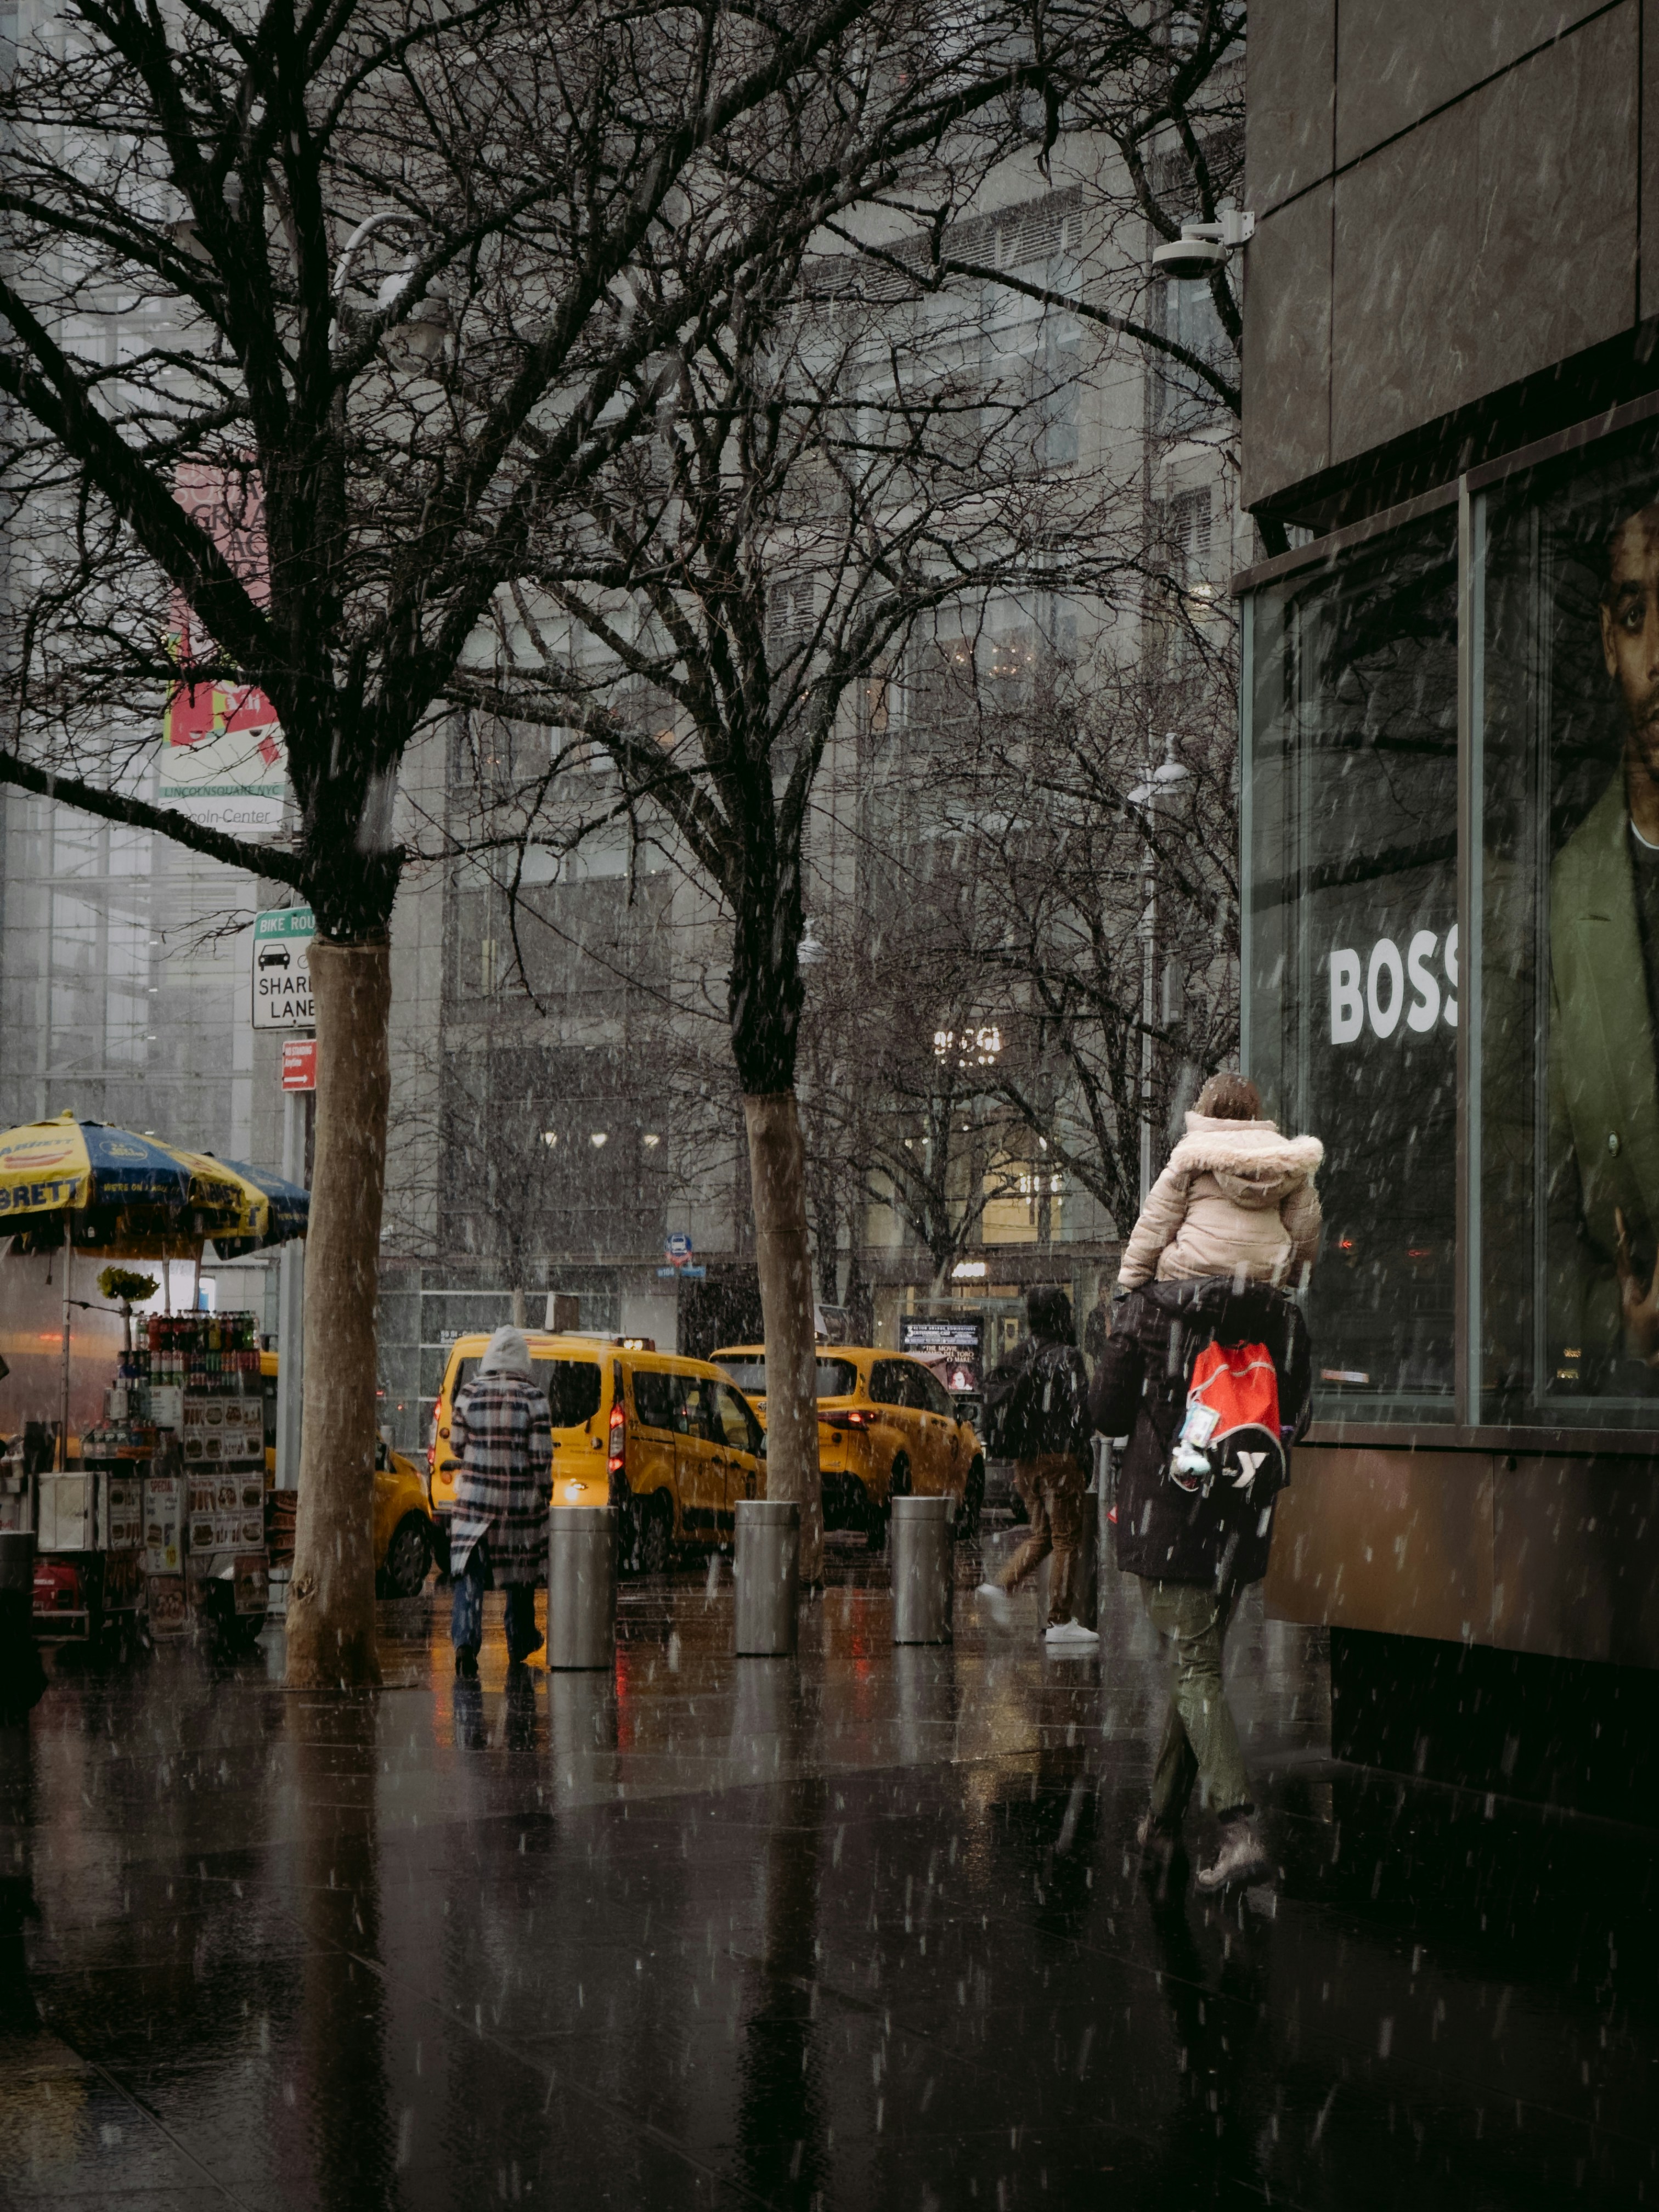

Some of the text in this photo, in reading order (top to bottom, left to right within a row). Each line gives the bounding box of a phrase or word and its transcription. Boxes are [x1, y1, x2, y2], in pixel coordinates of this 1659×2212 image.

[190, 503, 268, 531] GREA
[189, 809, 270, 823] coln Center
[260, 916, 315, 933] BIKE ROU
[259, 977, 312, 995] SHAR
[0, 1176, 81, 1210] BRETT
[907, 1326, 913, 1337] 3
